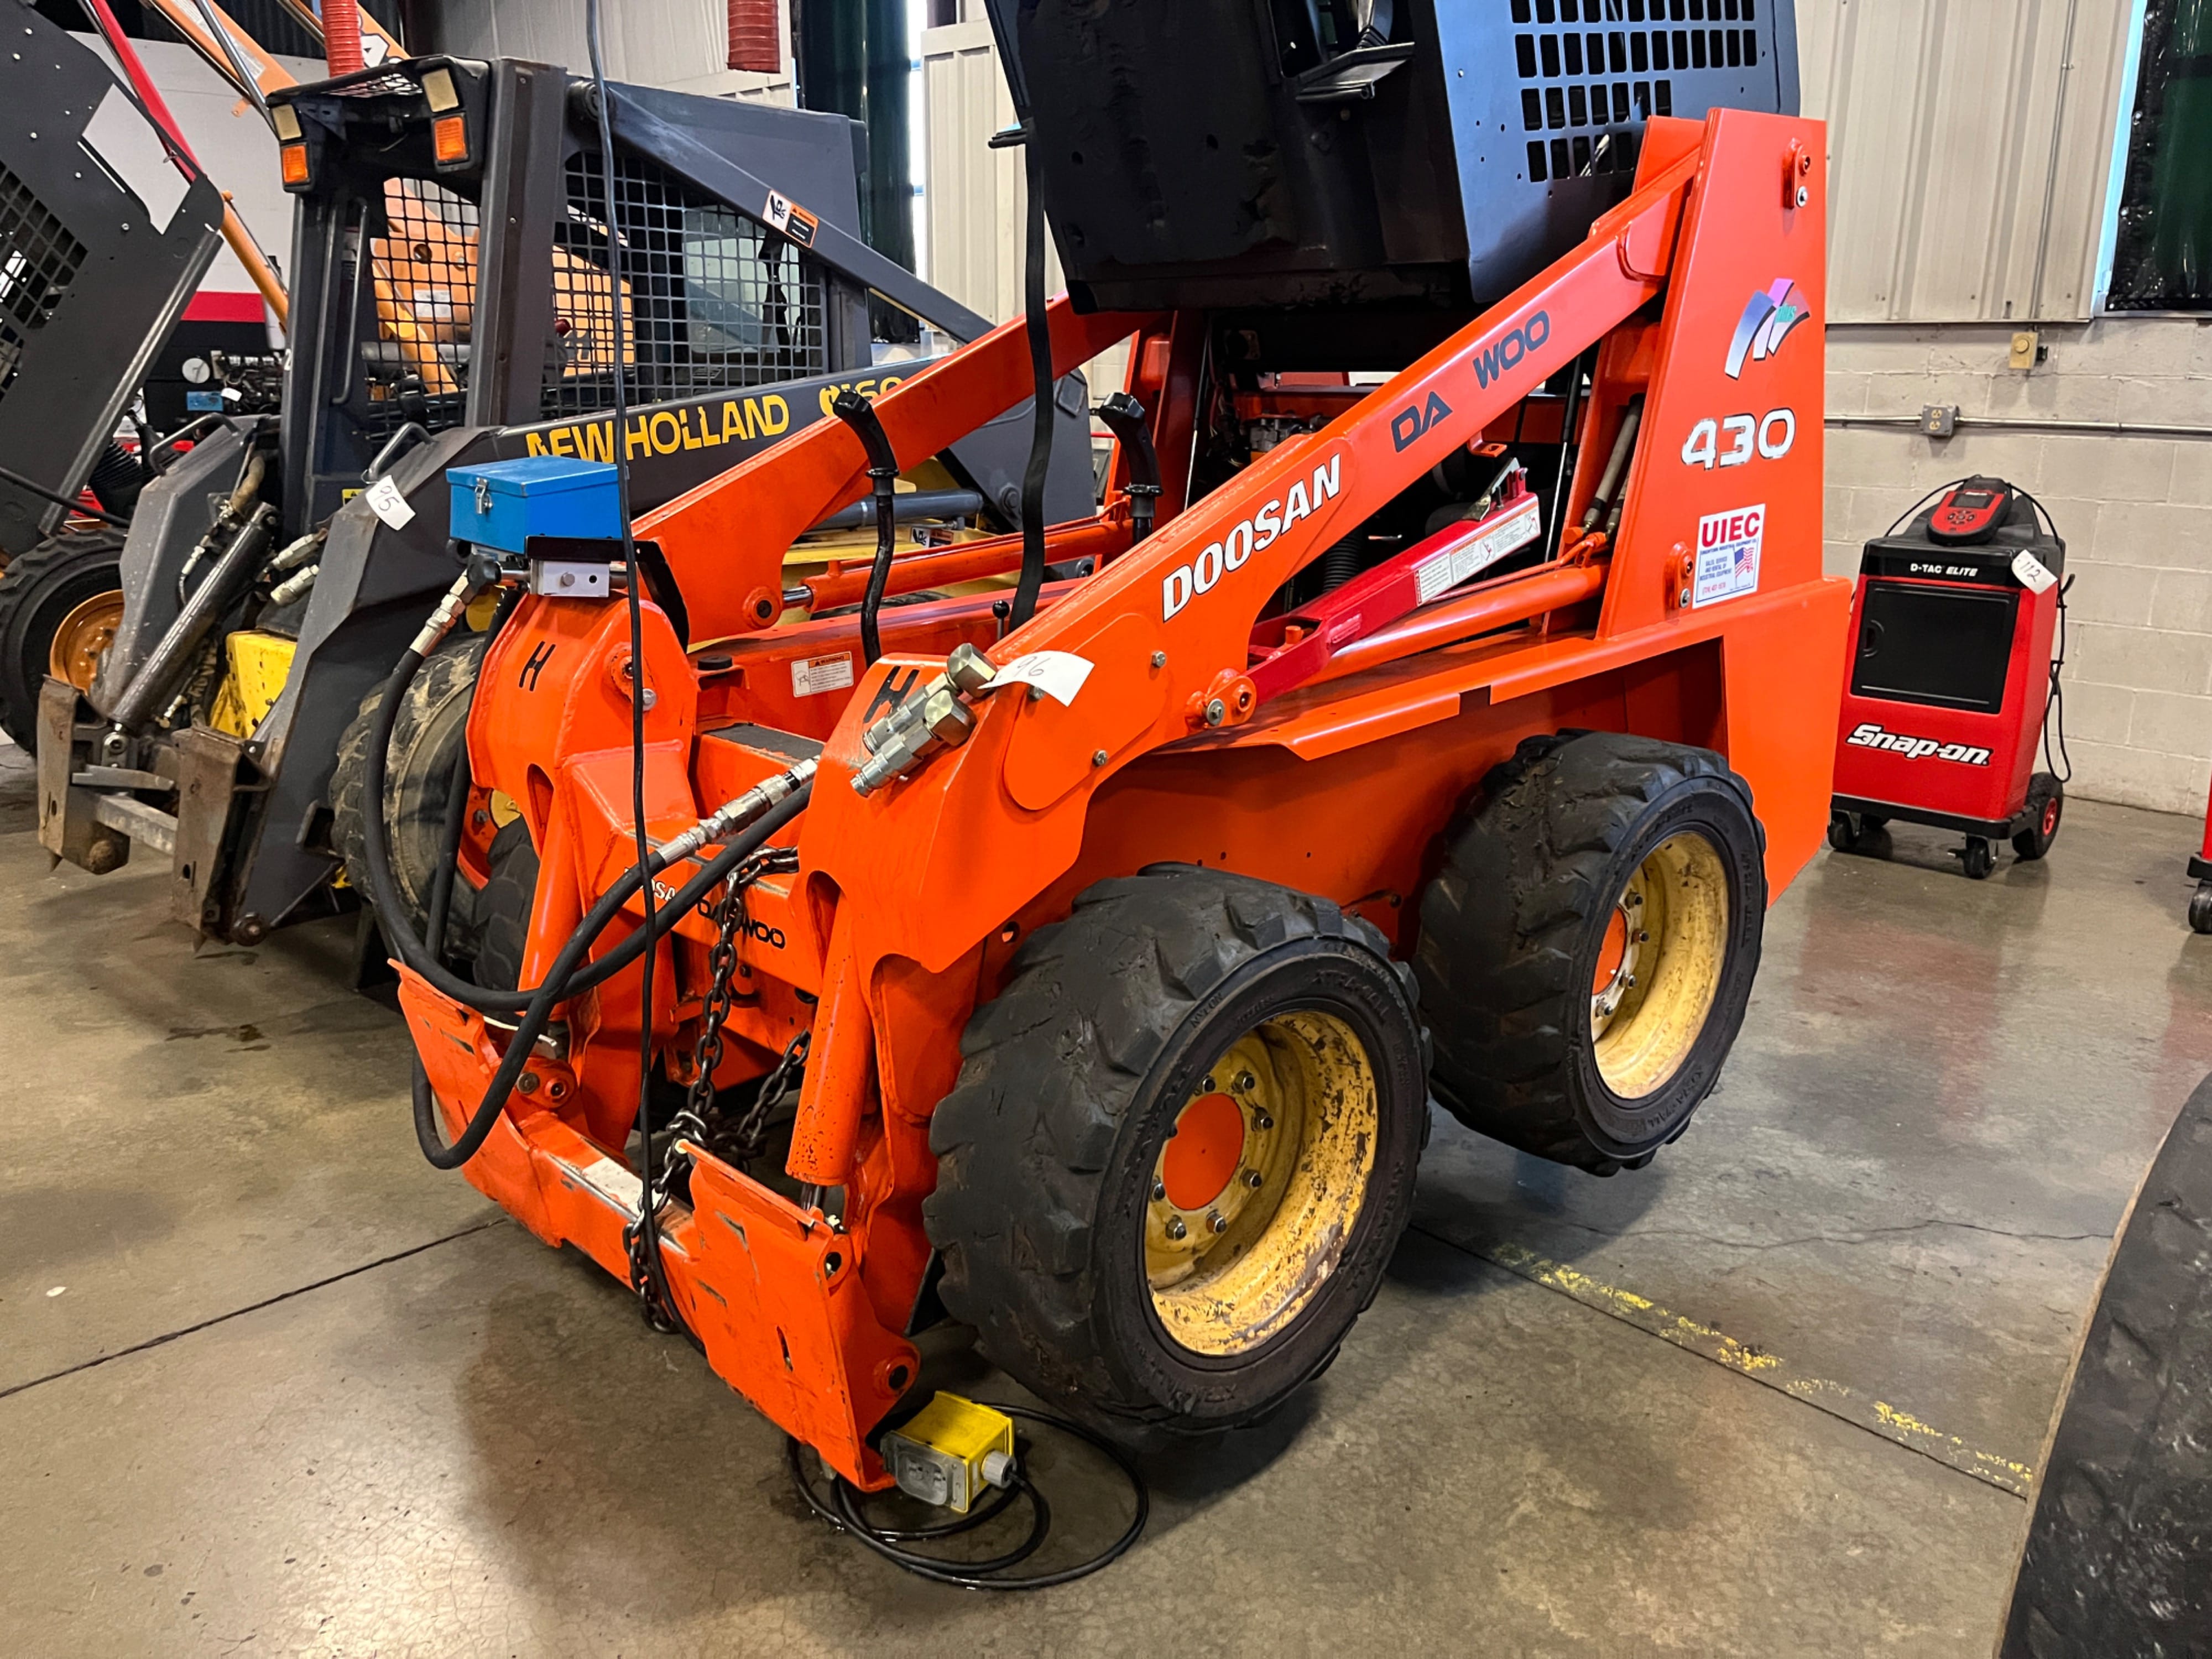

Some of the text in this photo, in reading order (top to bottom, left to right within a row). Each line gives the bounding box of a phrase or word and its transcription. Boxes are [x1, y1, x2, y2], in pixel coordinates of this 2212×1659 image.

[1391, 310, 1550, 452] DA WOO
[625, 394, 790, 461] HOLLAND
[1681, 408, 1796, 471] 430
[373, 486, 400, 512] 95
[1162, 453, 1340, 622] DOOSAN
[1702, 512, 1760, 547] UIEC
[1910, 563, 1978, 577] D-TAC ELITE
[2019, 561, 2041, 582] 112
[1014, 656, 1051, 677] 96
[1846, 724, 1990, 765] Snap-on
